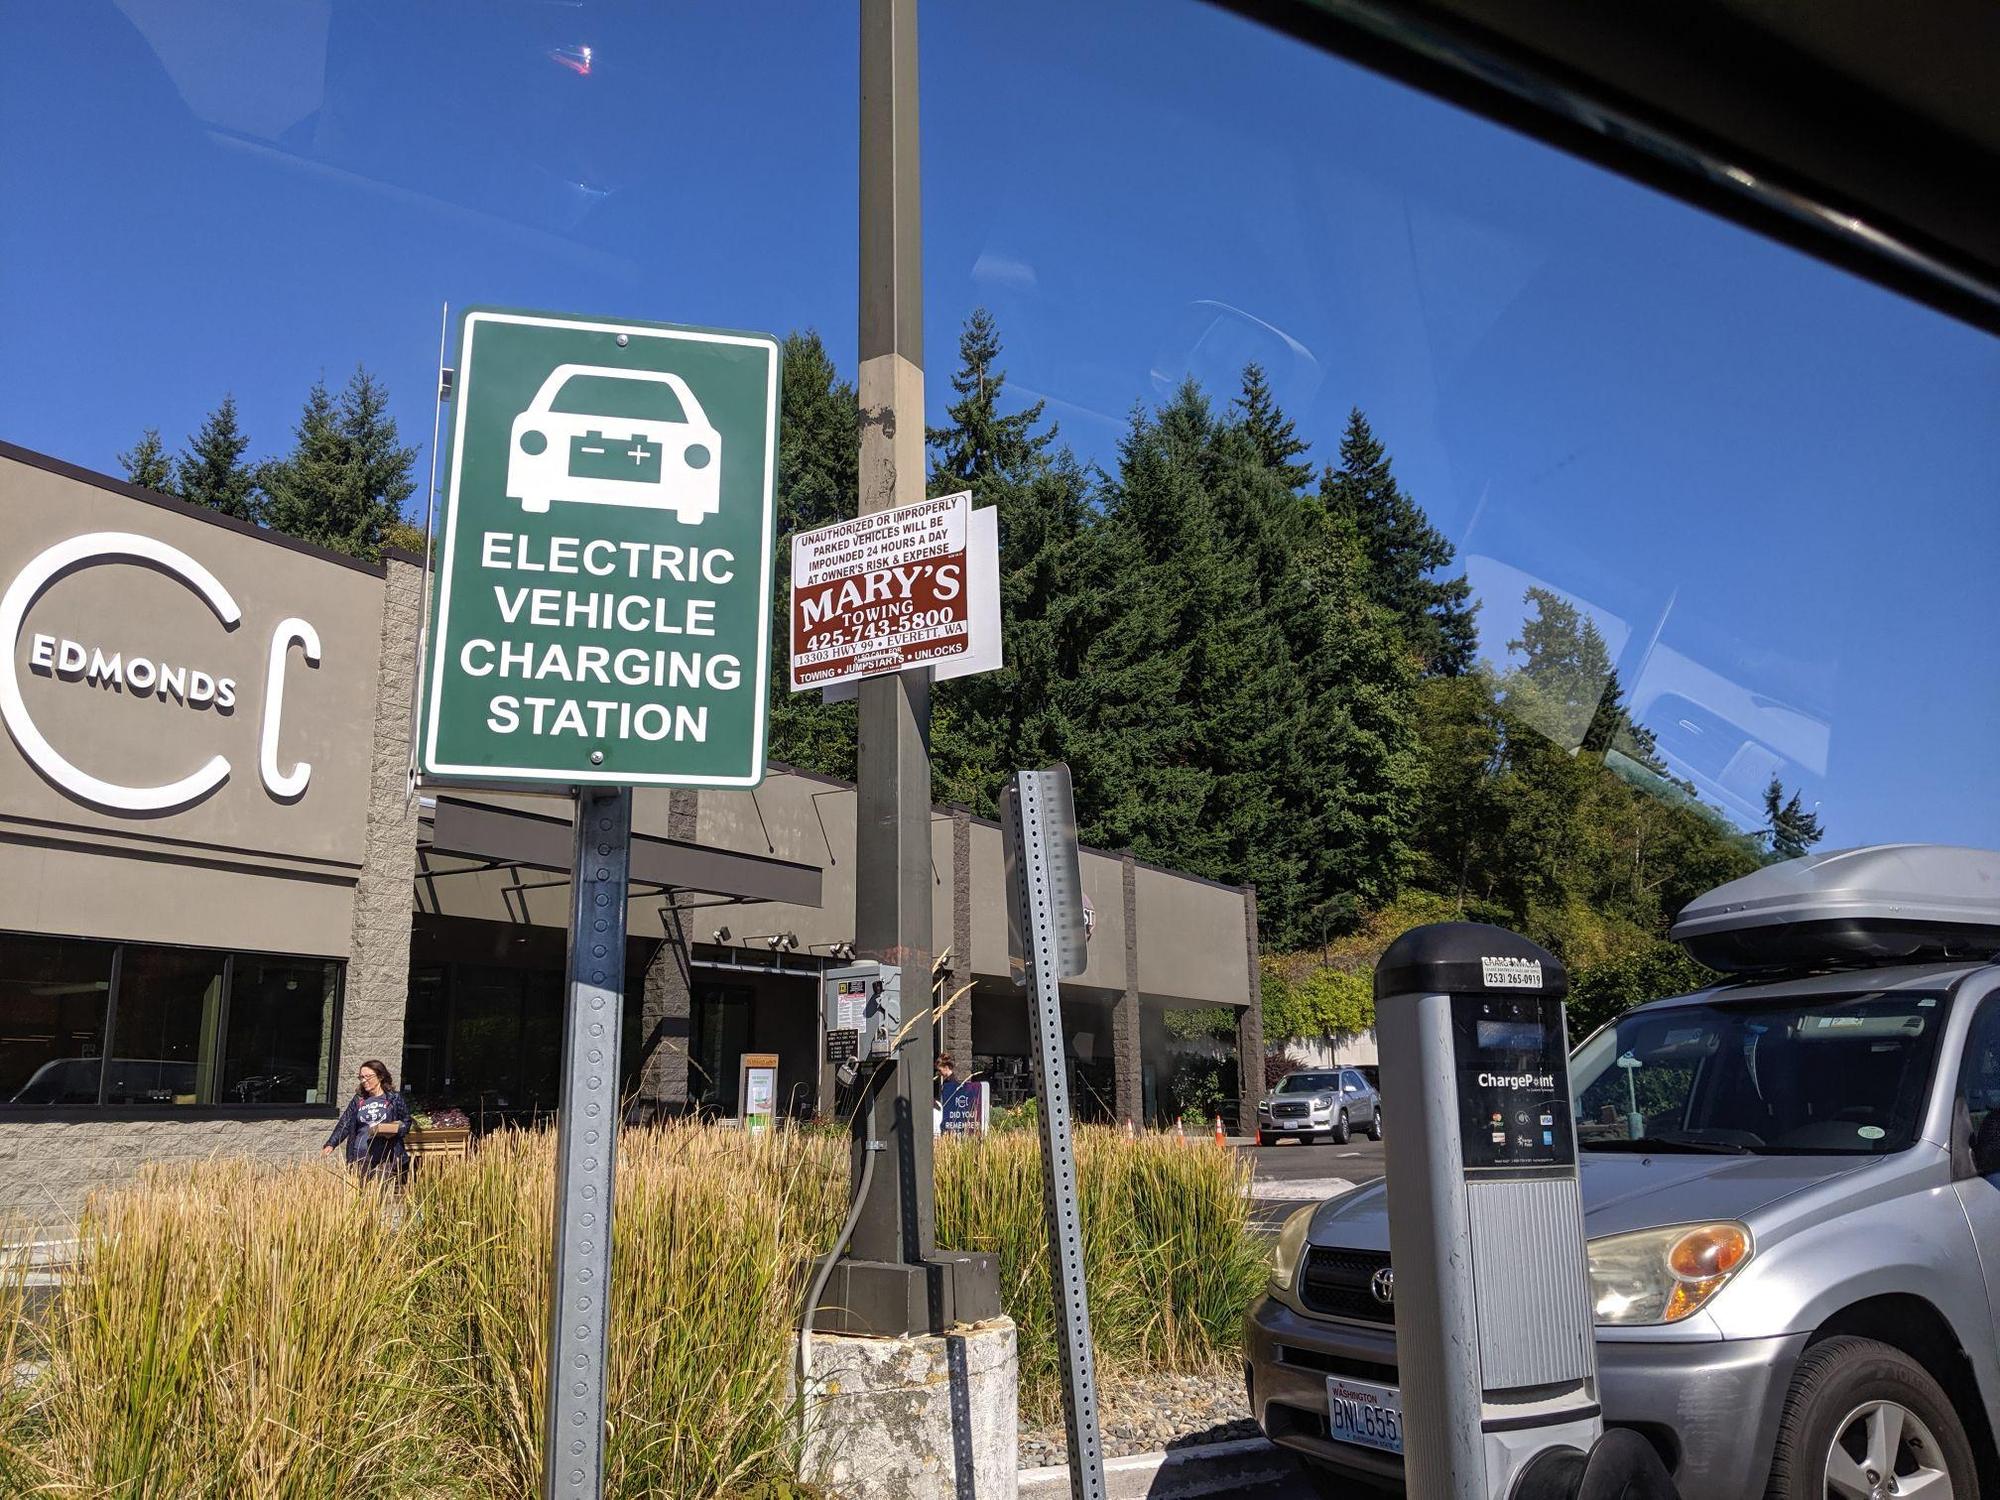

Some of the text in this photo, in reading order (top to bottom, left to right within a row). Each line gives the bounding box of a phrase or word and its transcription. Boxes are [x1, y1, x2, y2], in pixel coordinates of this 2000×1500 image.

[801, 498, 958, 547] UNAUTHORIZED OR IMPROPERLY
[813, 516, 943, 557] PARKED VEHICLES WILL BE
[481, 531, 736, 585] ELECTRIC
[807, 573, 819, 586] AT
[821, 563, 864, 582] OWNER'S
[866, 556, 890, 571] RISK
[903, 542, 950, 562] EXPENSE
[809, 529, 948, 572] IMPOUNDED 24 HOURS A DAY
[494, 586, 717, 637] VEHICLE
[800, 564, 960, 633] MARY'S
[842, 600, 914, 627] TOWING
[798, 651, 829, 666] 13303
[832, 643, 858, 658] HWY
[861, 640, 874, 651] 99
[944, 624, 964, 635] WA
[806, 606, 954, 651] 425-743-5800
[30, 633, 237, 710] EDMONDS
[460, 638, 742, 691] CHARGING
[799, 667, 835, 683] TOWING
[844, 653, 905, 674] JUMPSTARTS
[914, 642, 963, 661] UNLOCKS
[888, 647, 903, 655] FOR
[486, 695, 709, 743] STATION
[1485, 972, 1505, 984] (253)
[1478, 1073, 1555, 1090] ChargePoint
[949, 1111, 975, 1119] DID YOU
[1332, 1386, 1378, 1404] WASHINGTON
